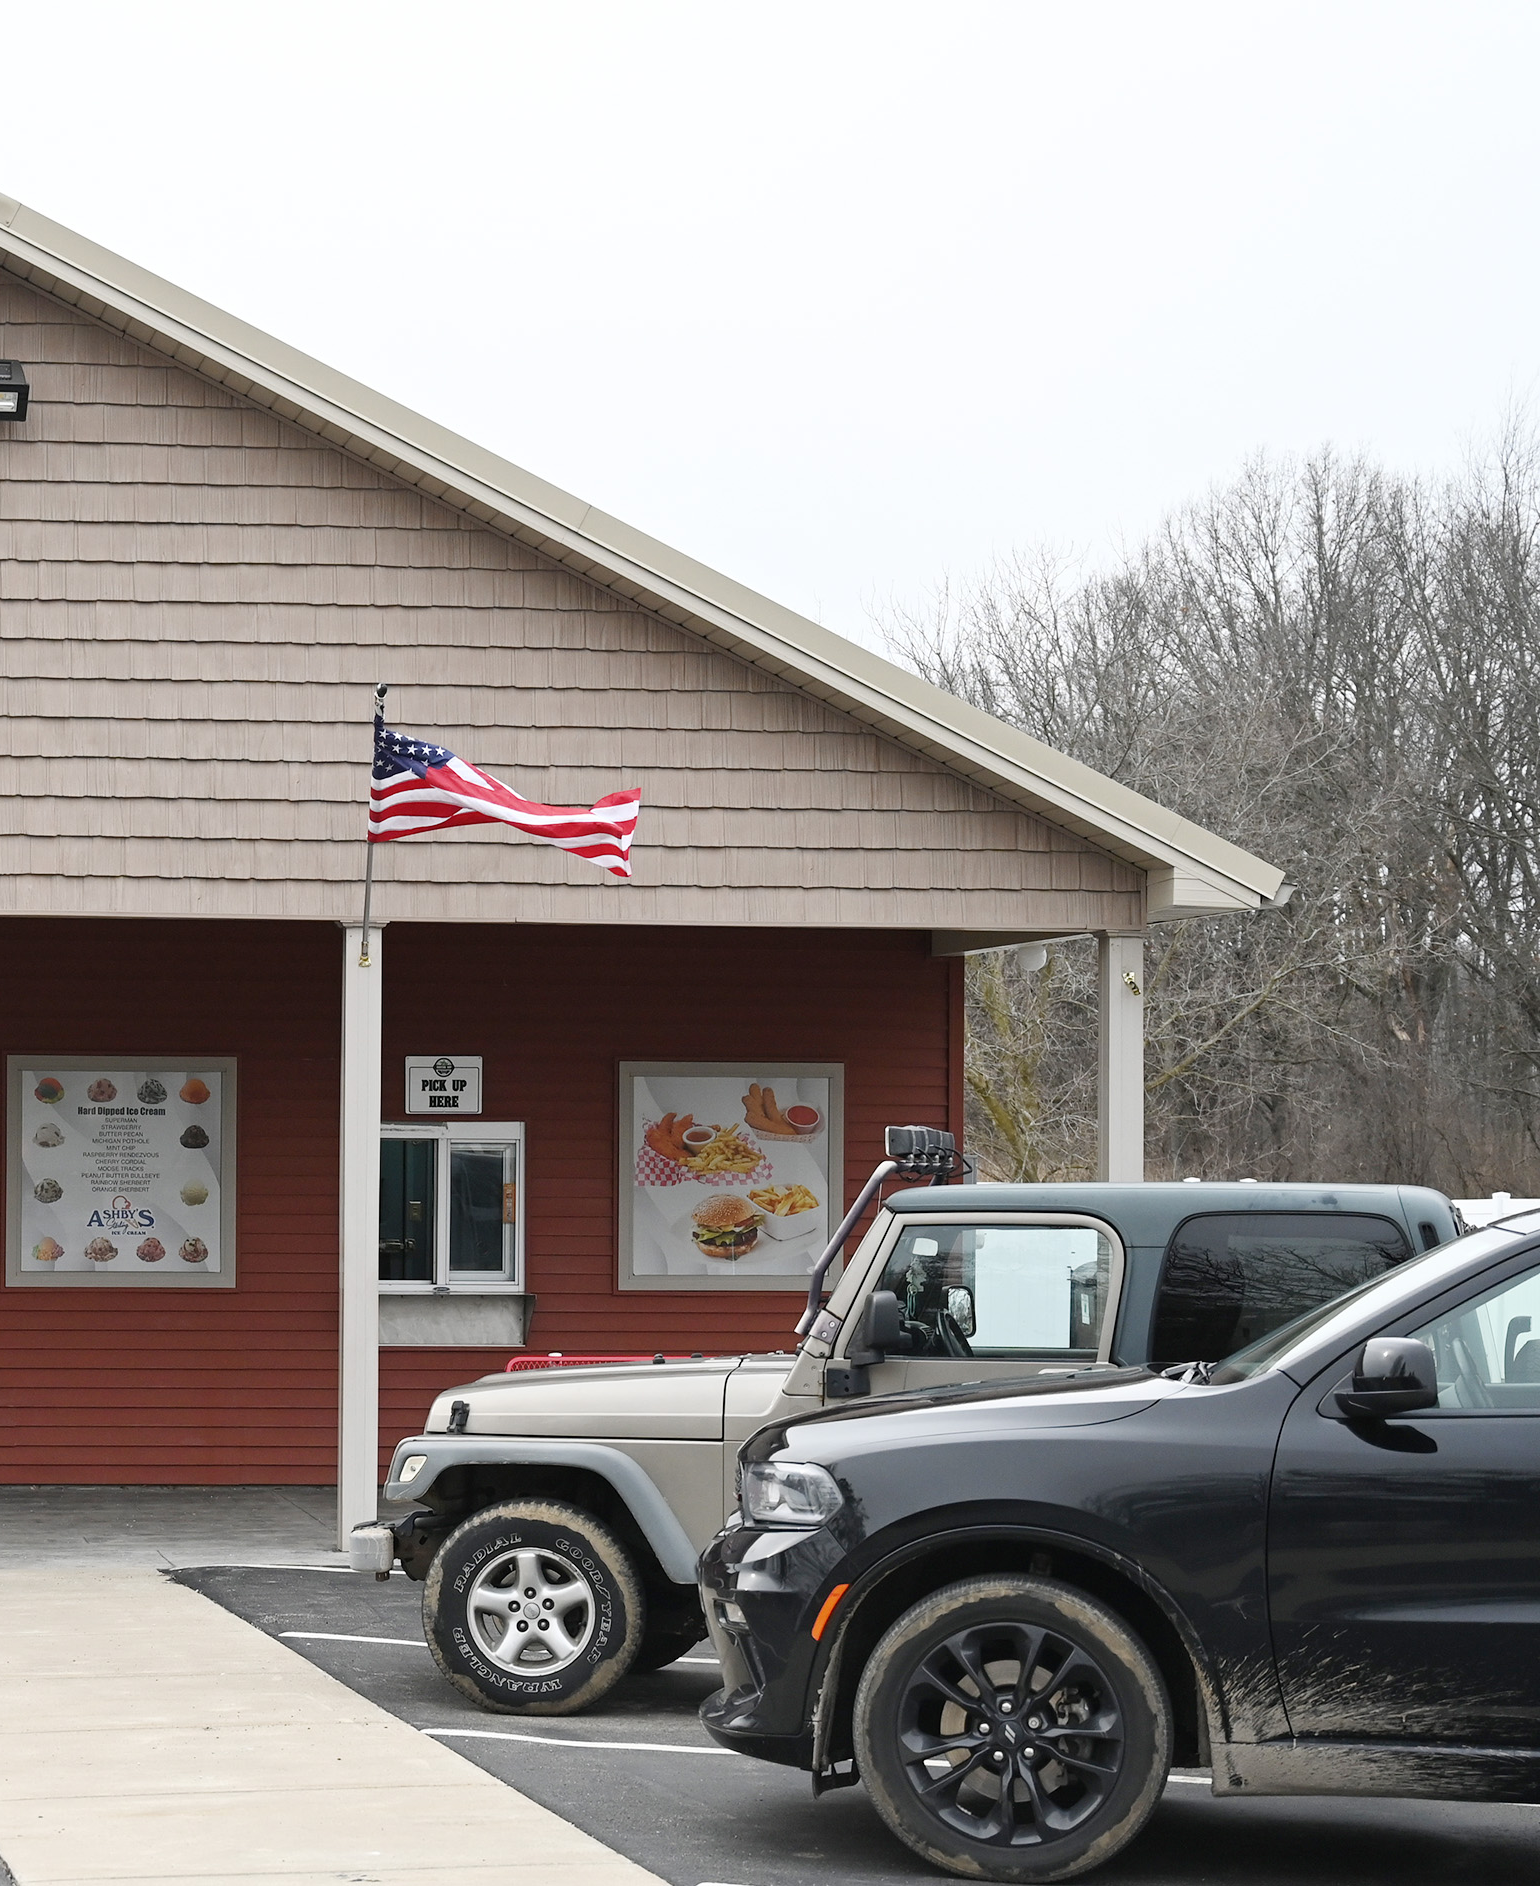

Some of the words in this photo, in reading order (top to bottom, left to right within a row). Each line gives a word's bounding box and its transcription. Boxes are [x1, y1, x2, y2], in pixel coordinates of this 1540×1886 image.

[422, 1080, 447, 1091] PICK
[452, 1080, 467, 1091] UP
[429, 1096, 459, 1107] HERE
[98, 1107, 124, 1116] Dipped
[127, 1107, 138, 1115] Ice
[140, 1107, 165, 1115] Cream
[454, 1533, 522, 1593] RADIAL
[556, 1539, 611, 1664] GOODYEAR
[453, 1628, 562, 1692] WRANGLER
